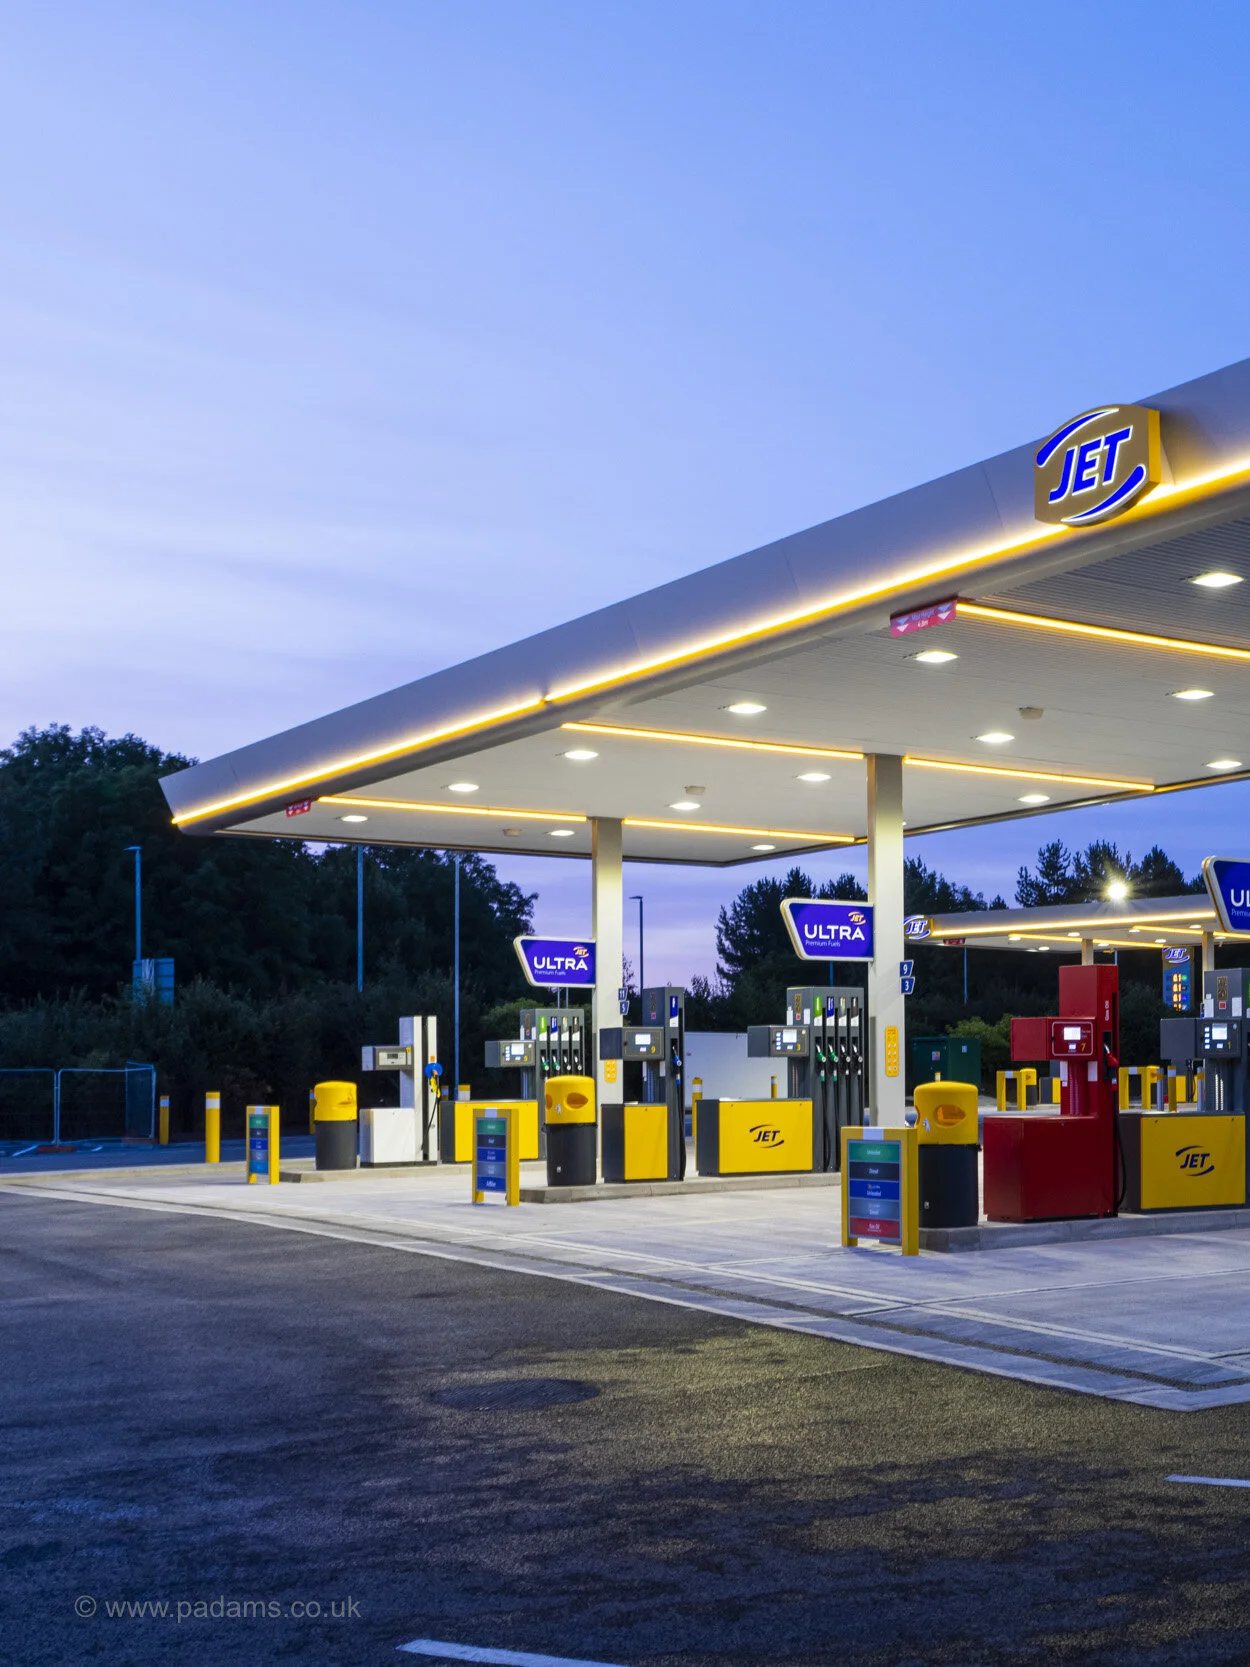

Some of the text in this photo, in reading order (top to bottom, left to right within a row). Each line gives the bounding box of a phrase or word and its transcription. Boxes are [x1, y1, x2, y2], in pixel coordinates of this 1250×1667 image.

[1048, 424, 1133, 504] JET
[850, 914, 864, 923] JET
[804, 924, 865, 941] ULTRA
[905, 920, 928, 934] JET
[805, 939, 841, 948] Premium Fuels
[1165, 948, 1187, 959] JET
[533, 956, 588, 971] ULTRA
[753, 1130, 781, 1142] JET
[1180, 1153, 1210, 1169] JET
